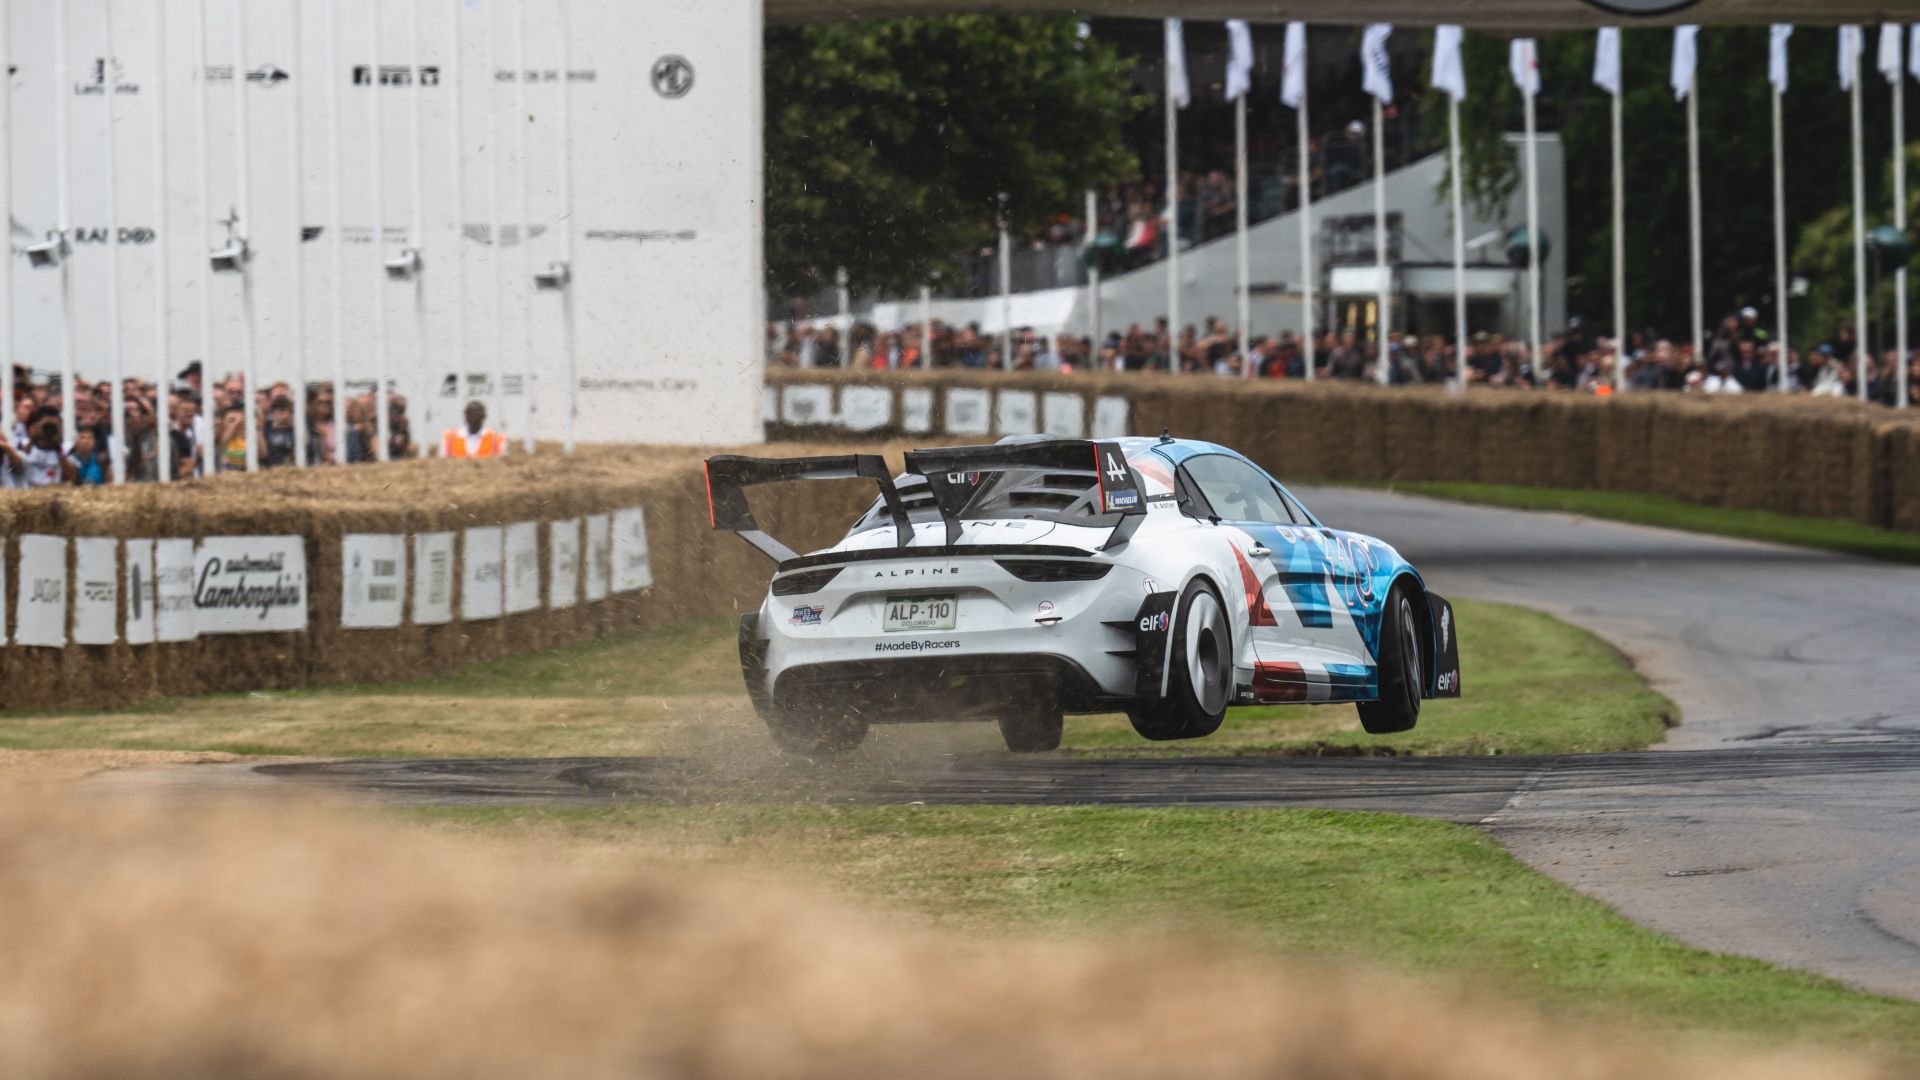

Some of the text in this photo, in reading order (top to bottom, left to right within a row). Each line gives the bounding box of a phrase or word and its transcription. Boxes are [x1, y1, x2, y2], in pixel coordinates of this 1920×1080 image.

[874, 567, 960, 578] ALPINE
[194, 557, 302, 619] Lamborghini
[1140, 615, 1159, 632] elf
[875, 640, 961, 652] #MadeByRacers
[1438, 672, 1452, 690] elf
